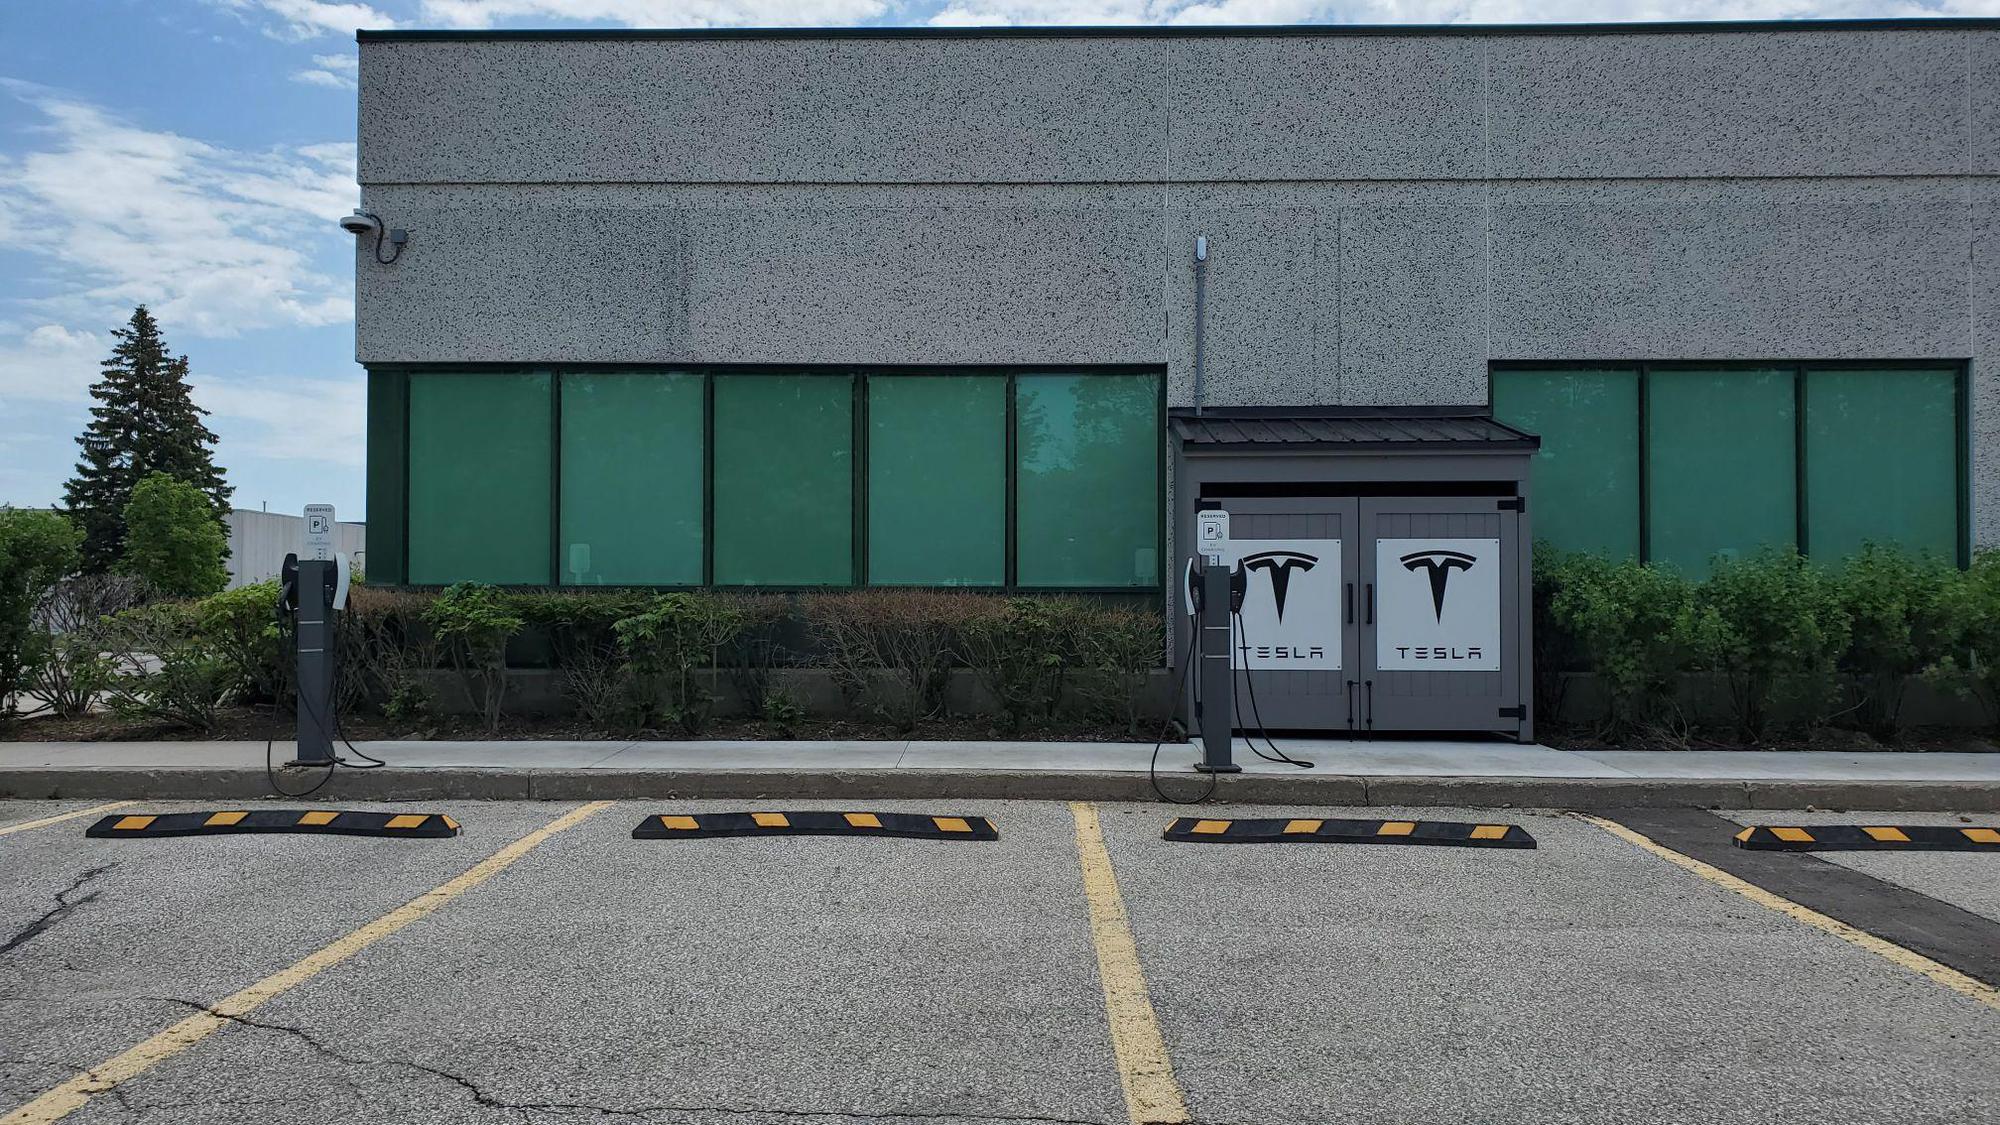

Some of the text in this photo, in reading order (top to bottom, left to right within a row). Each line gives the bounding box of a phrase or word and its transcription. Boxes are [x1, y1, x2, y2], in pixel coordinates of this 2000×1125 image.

[313, 520, 320, 529] P
[1207, 527, 1214, 535] P
[1237, 646, 1323, 660] TESLA
[1395, 647, 1482, 660] TESLA
